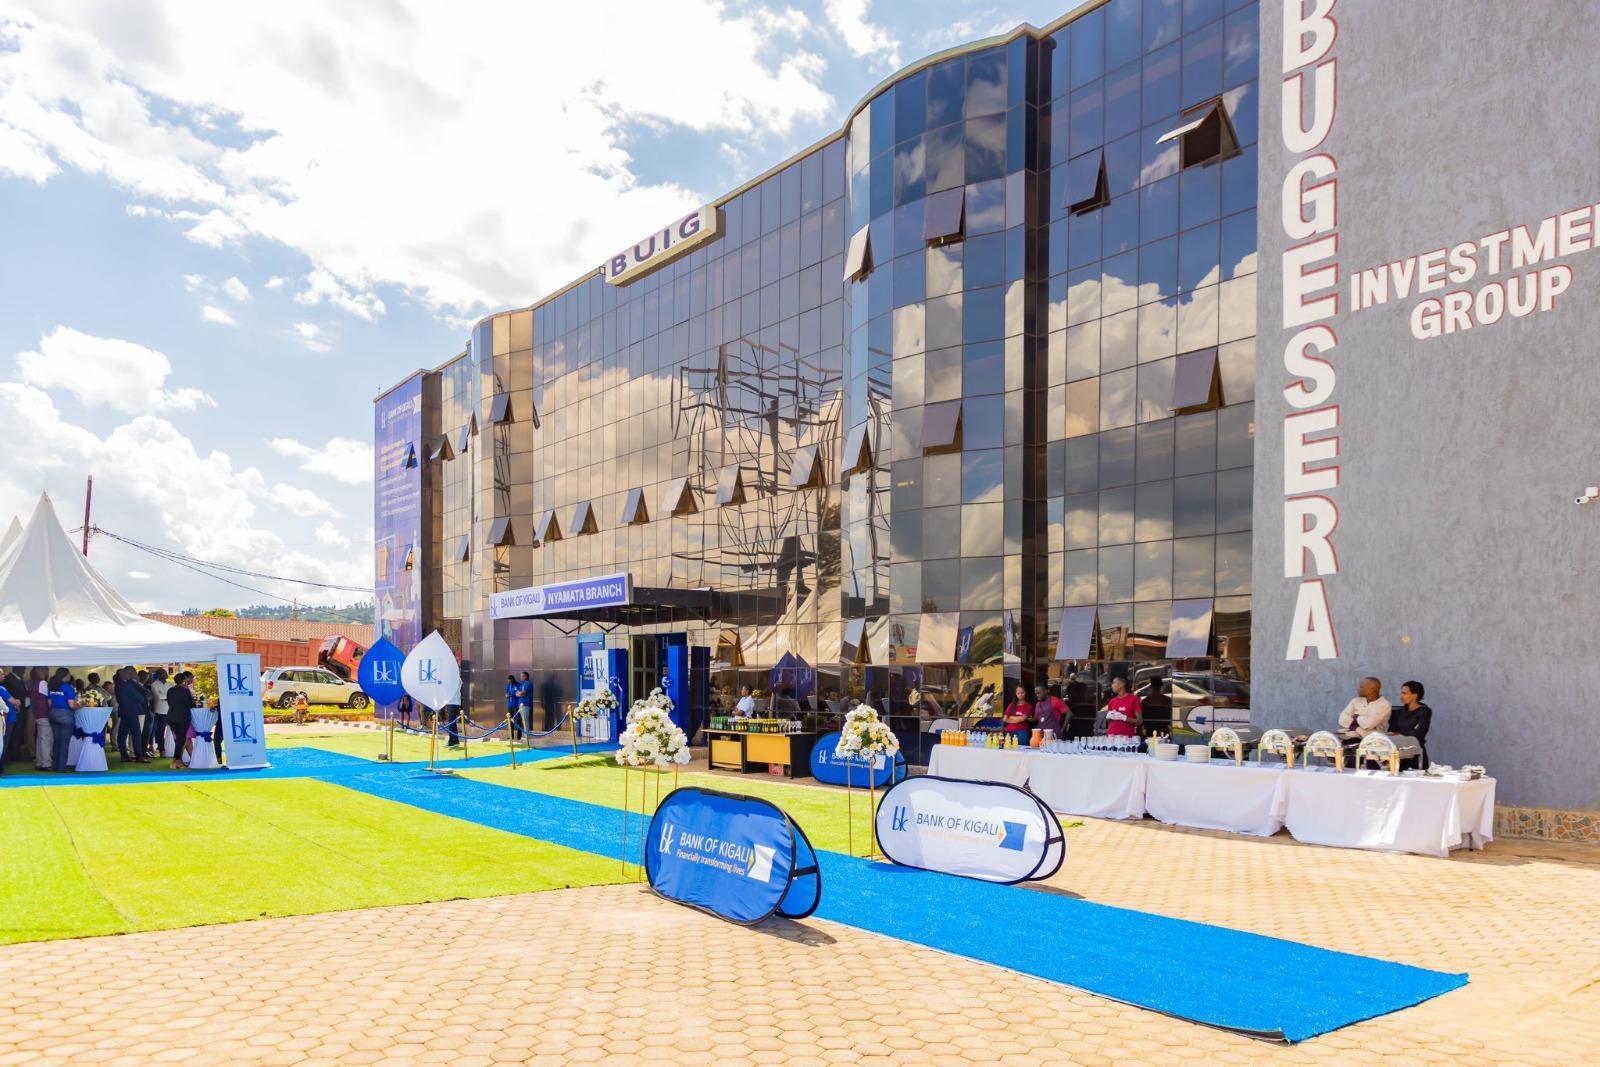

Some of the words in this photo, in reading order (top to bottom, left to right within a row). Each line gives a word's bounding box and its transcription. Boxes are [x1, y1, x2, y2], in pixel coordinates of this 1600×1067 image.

[1410, 264, 1573, 340] GROUP
[1282, 0, 1340, 661] BUGESERA
[501, 597, 515, 608] BANK
[548, 589, 584, 605] NYAMATA
[586, 583, 622, 600] BRANCH
[584, 656, 593, 669] AT
[916, 813, 944, 828] BANK
[947, 817, 961, 830] OF
[963, 820, 999, 836] KIGALI
[680, 832, 704, 850] BANK
[705, 837, 718, 853] OF
[718, 841, 750, 863] KIGALI
